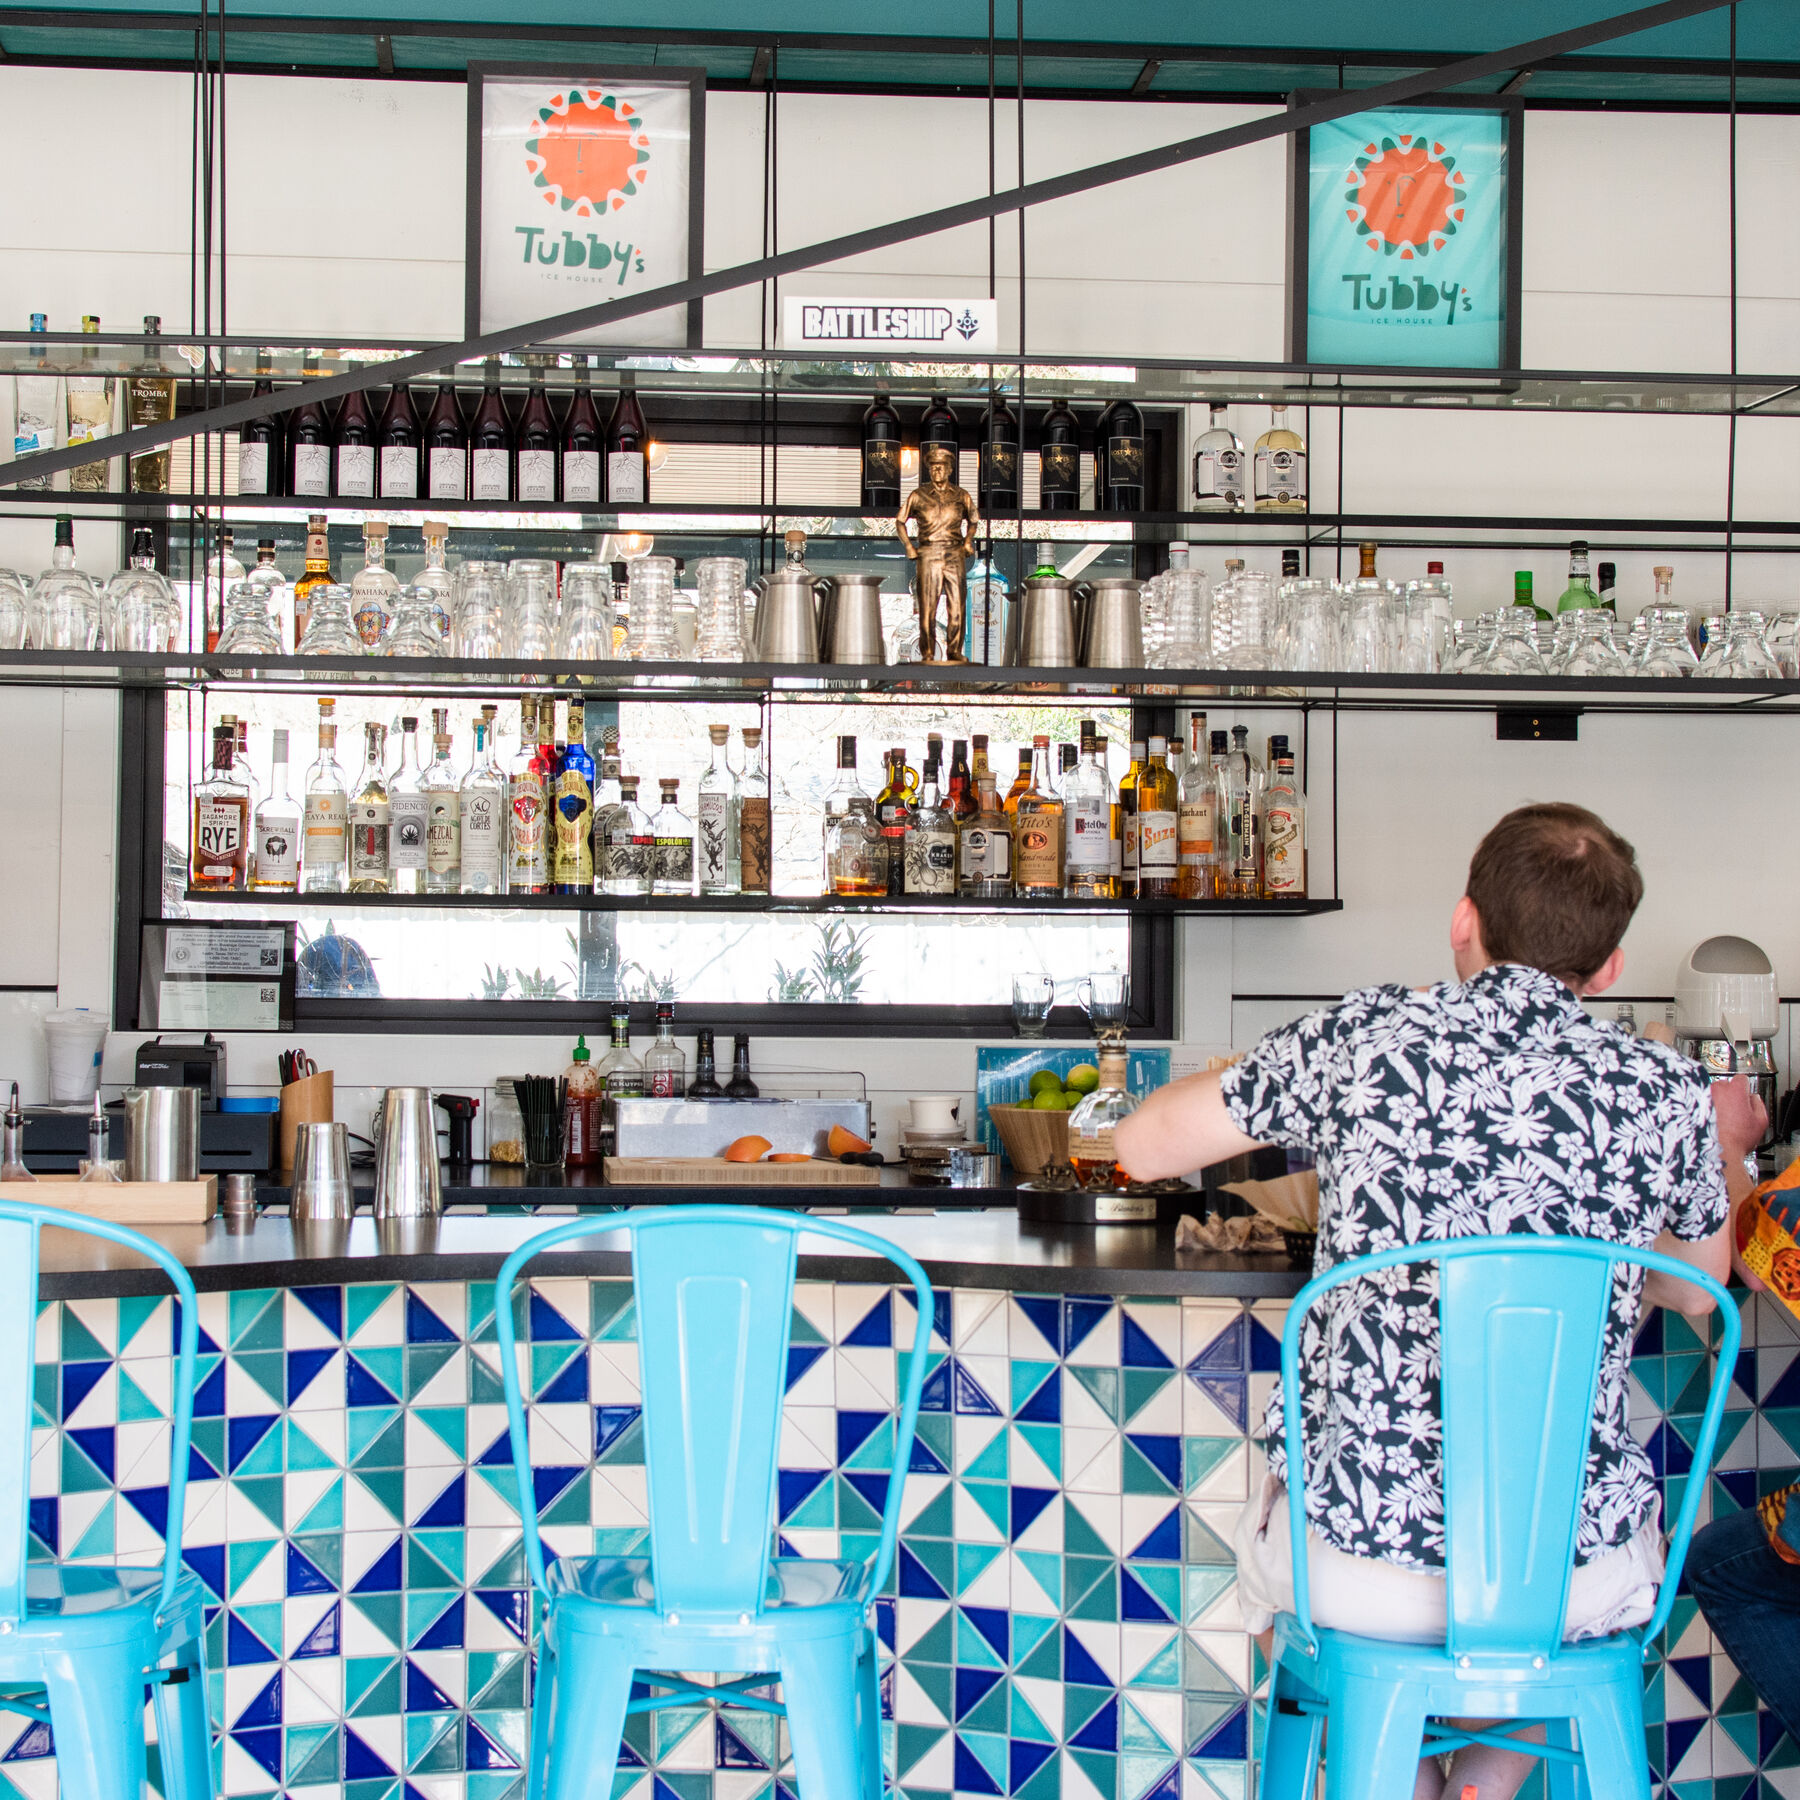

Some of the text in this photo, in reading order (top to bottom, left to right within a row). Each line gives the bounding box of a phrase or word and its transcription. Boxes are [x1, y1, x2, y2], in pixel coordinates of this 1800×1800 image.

[515, 226, 645, 286] Tubby's
[541, 273, 604, 284] ICE HOUSE
[1342, 274, 1472, 325] Tubby's
[803, 306, 952, 341] BATTLESHIP
[131, 389, 168, 398] TROMBA
[1020, 816, 1052, 830] Tito's
[1096, 820, 1108, 830] One
[201, 826, 237, 853] RYE
[1144, 827, 1176, 851] Suze
